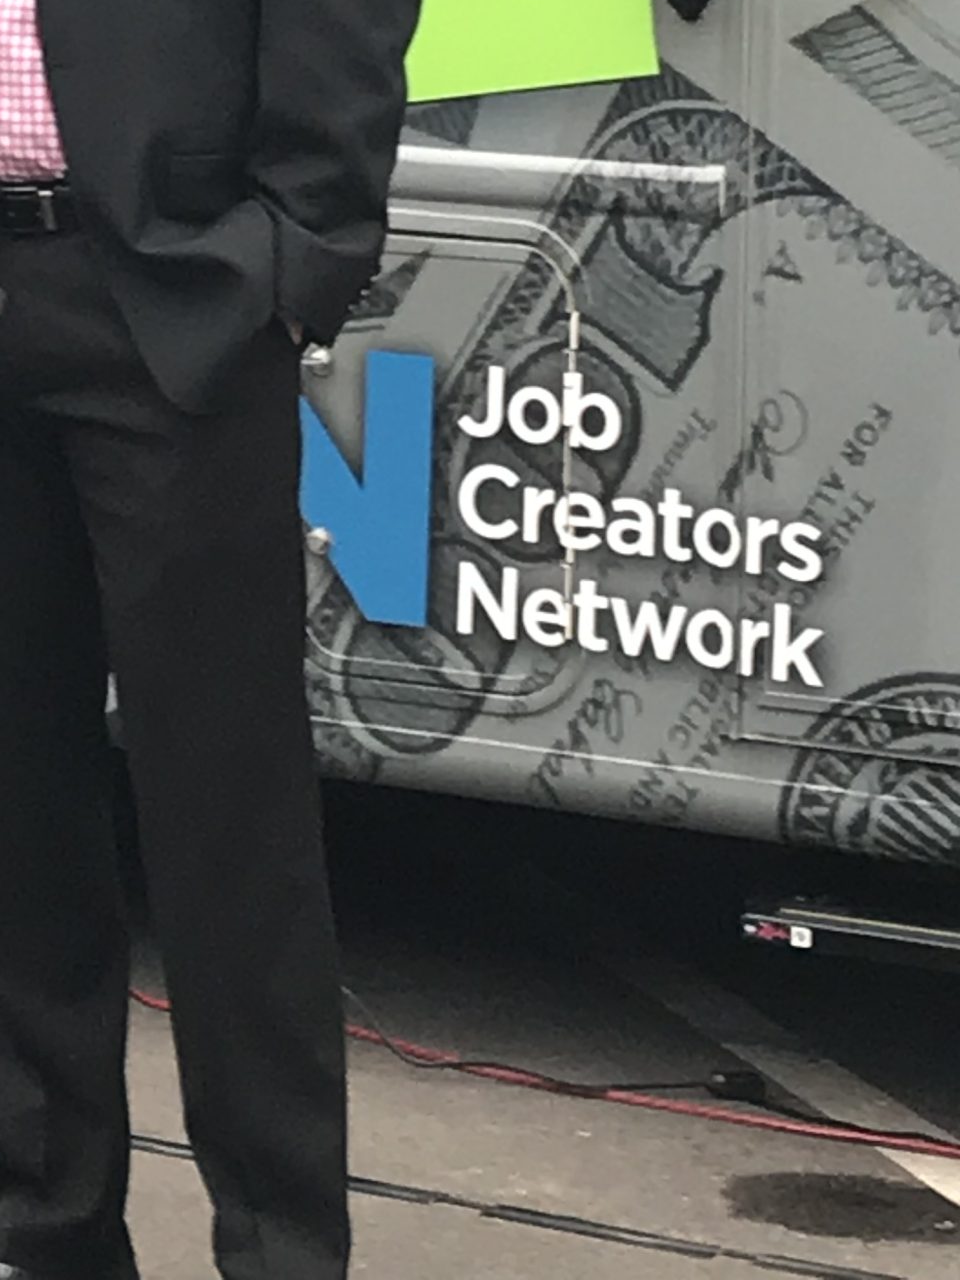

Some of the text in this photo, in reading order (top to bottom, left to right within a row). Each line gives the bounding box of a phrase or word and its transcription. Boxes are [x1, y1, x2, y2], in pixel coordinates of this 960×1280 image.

[458, 365, 622, 452] Job
[458, 463, 823, 583] Creators
[456, 561, 824, 688] Network
